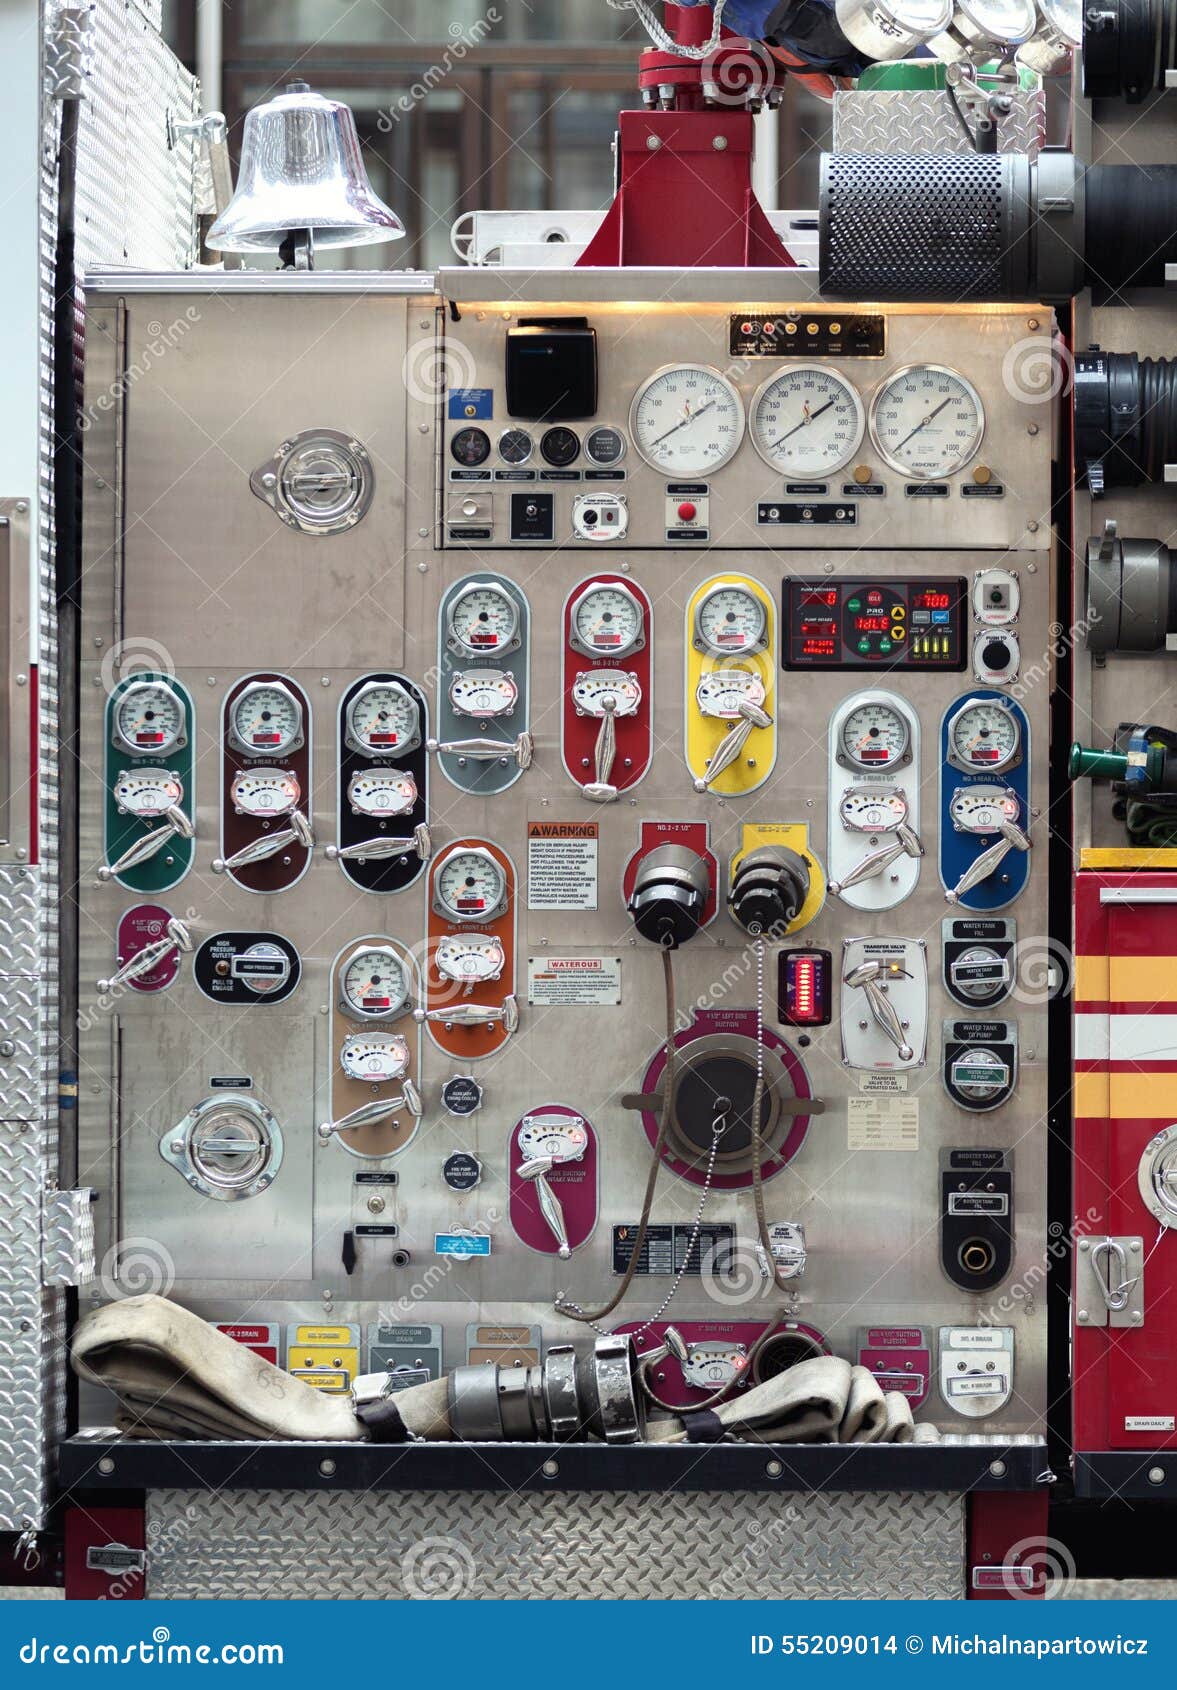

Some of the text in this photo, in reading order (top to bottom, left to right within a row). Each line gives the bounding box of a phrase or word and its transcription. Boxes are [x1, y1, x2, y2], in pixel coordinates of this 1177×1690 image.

[834, 432, 845, 440] 550
[888, 428, 898, 436] 100
[924, 594, 949, 608] 700
[541, 825, 595, 837] WARNING
